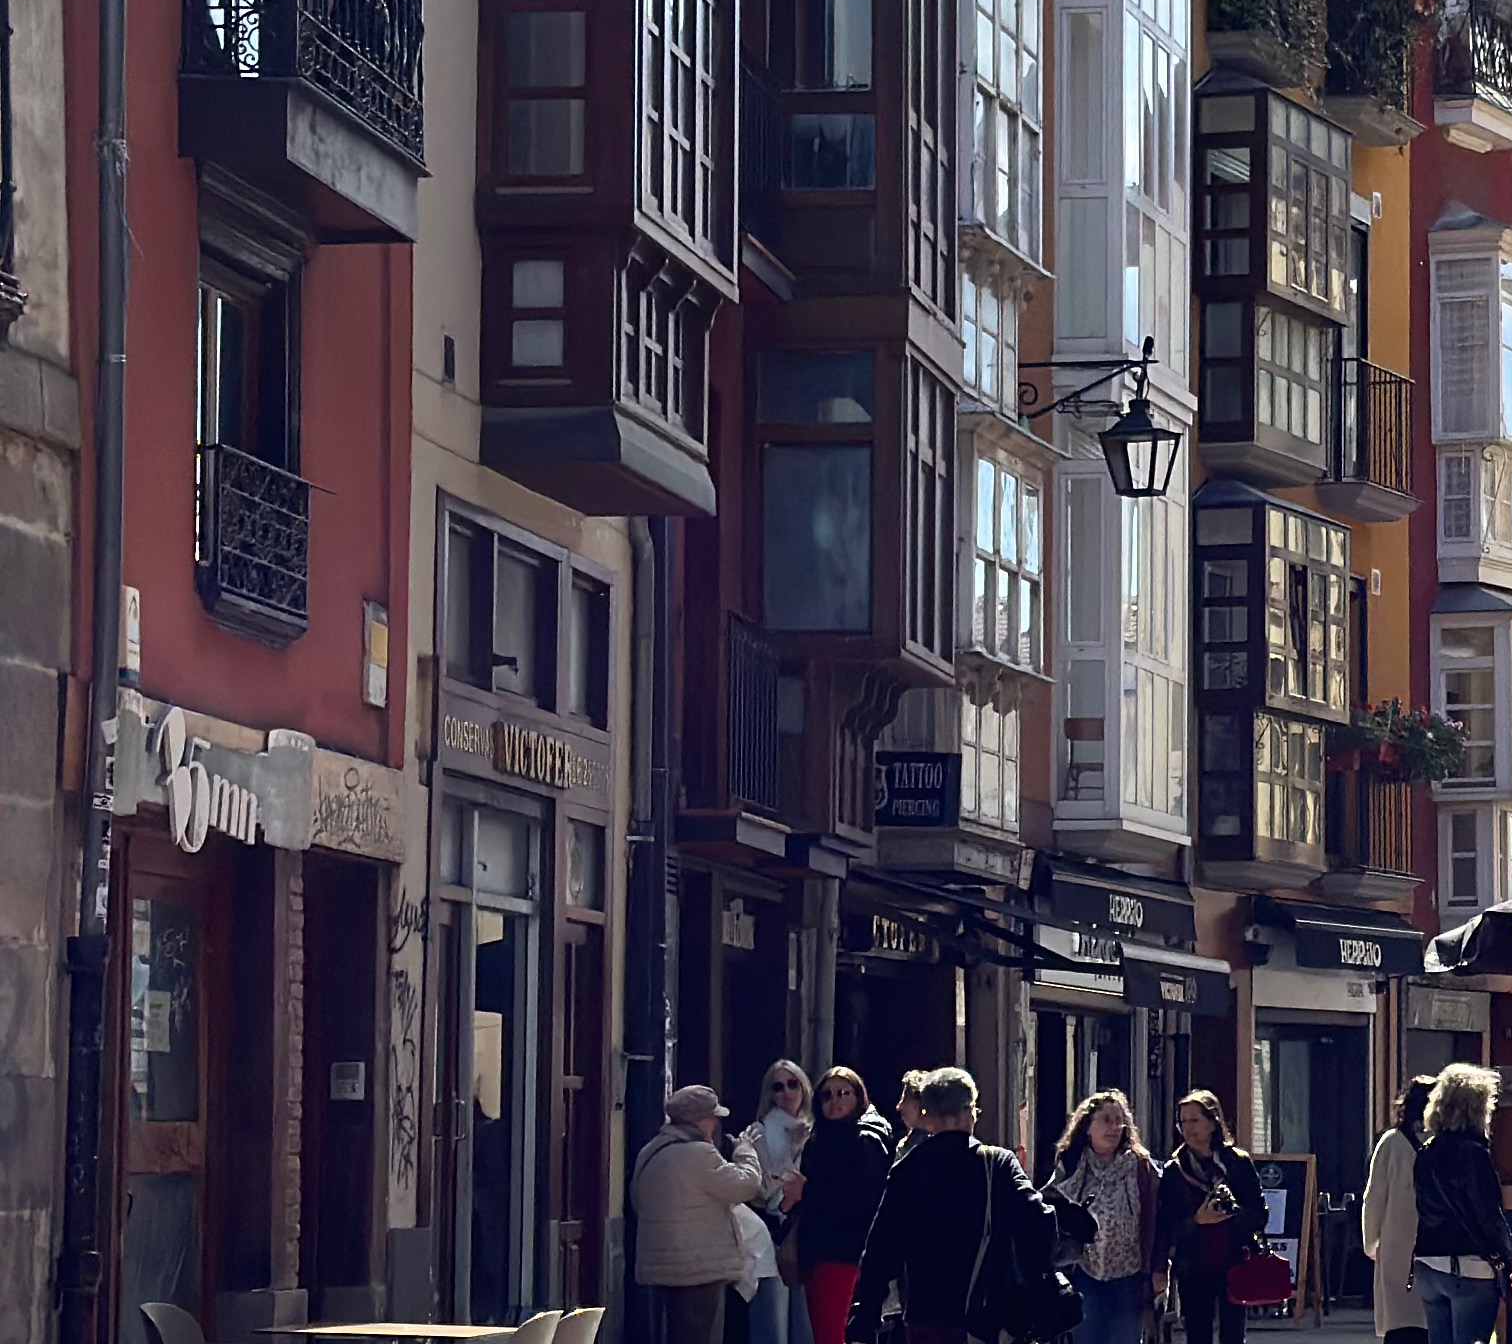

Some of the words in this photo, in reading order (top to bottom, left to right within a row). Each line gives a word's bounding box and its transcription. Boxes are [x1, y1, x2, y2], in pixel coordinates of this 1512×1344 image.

[503, 721, 572, 790] VICTOFER
[893, 761, 943, 789] TATTOO
[891, 799, 941, 818] PIERCING
